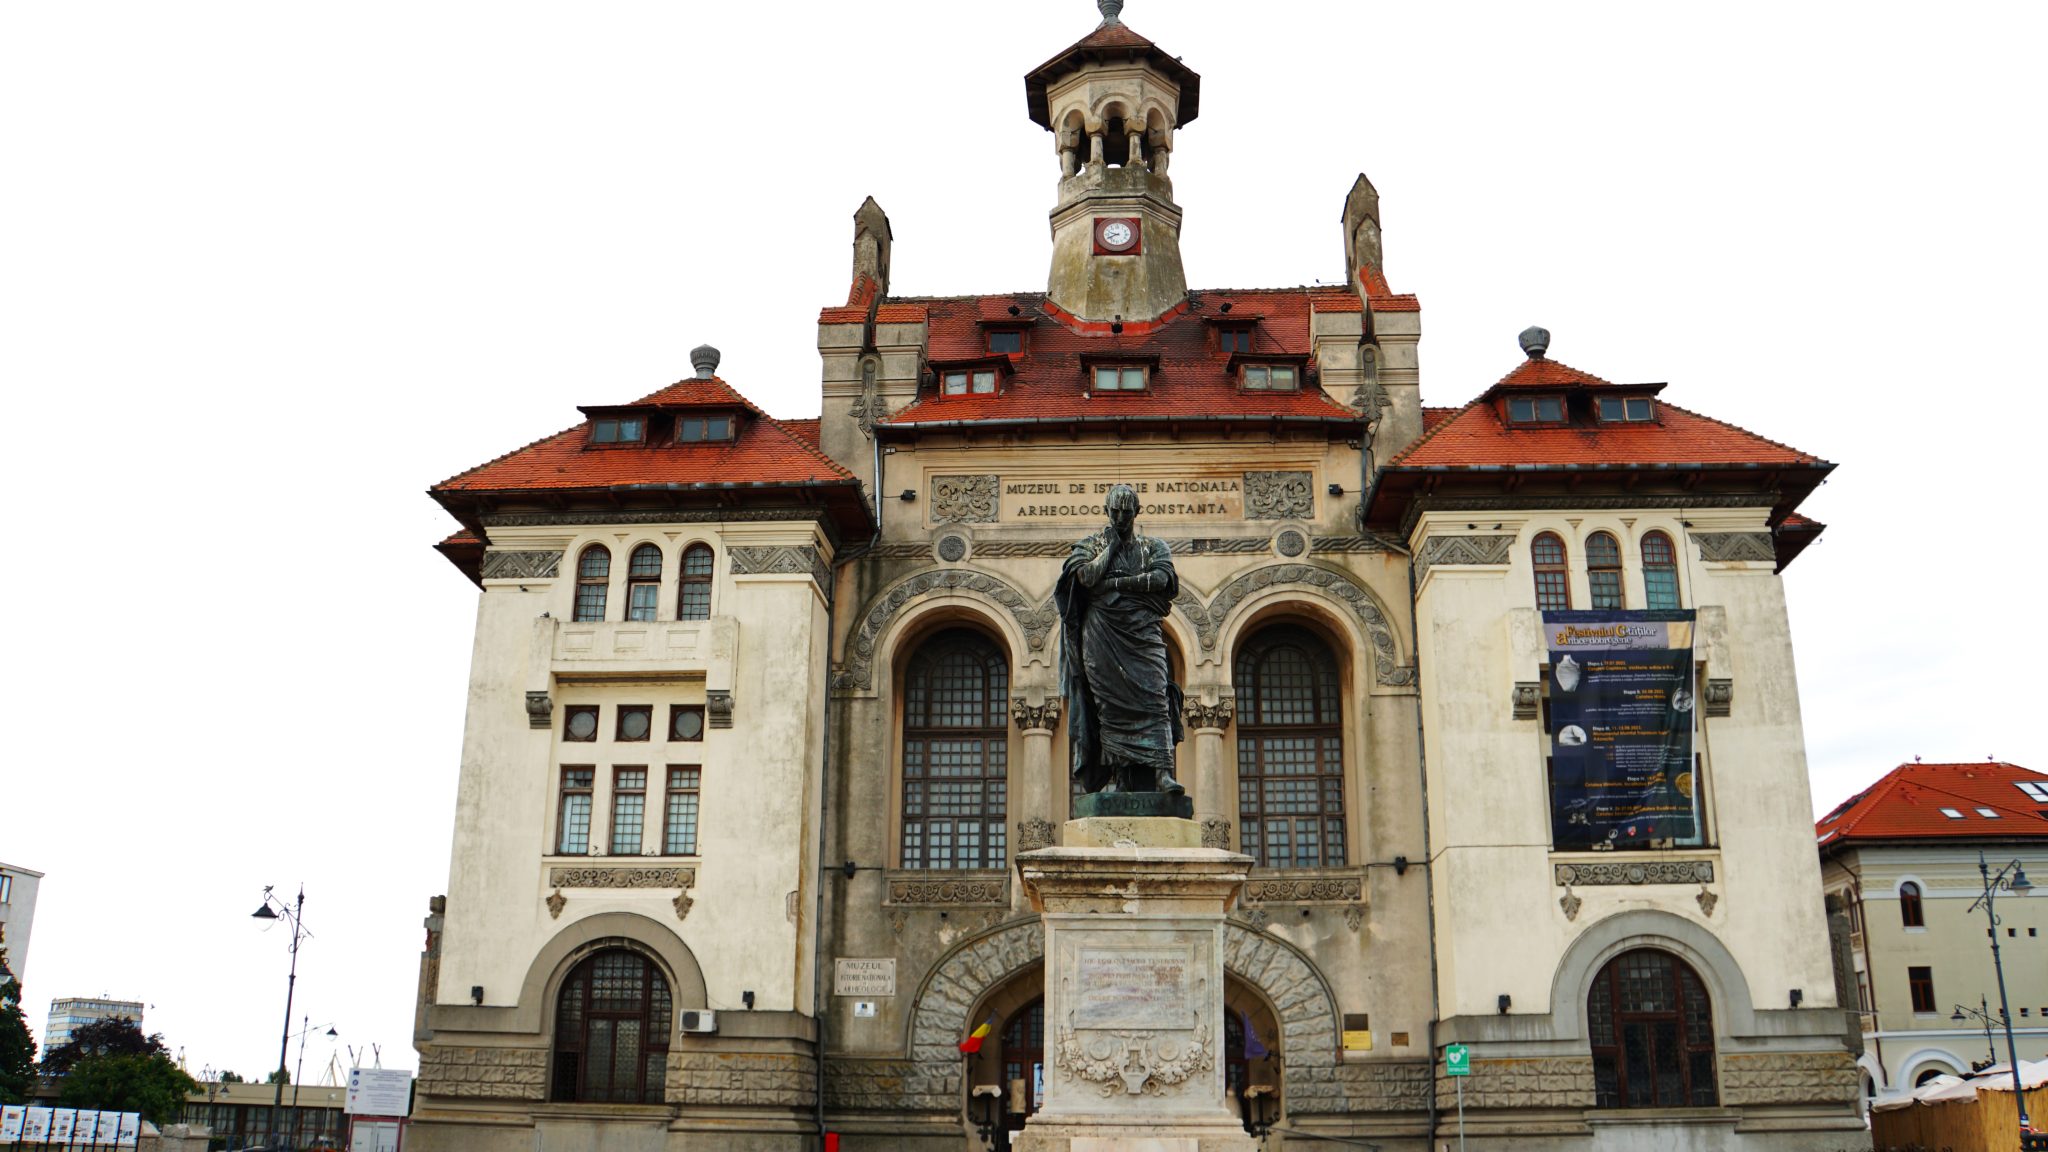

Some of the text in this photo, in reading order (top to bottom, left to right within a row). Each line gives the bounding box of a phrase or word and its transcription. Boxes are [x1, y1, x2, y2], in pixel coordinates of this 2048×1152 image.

[1006, 481, 1240, 494] MUZEUL DE ISTIE NATIONALA
[1138, 503, 1228, 515] CONSTANTA
[1566, 625, 1615, 637] Festivalul
[846, 962, 883, 970] MUZEUL
